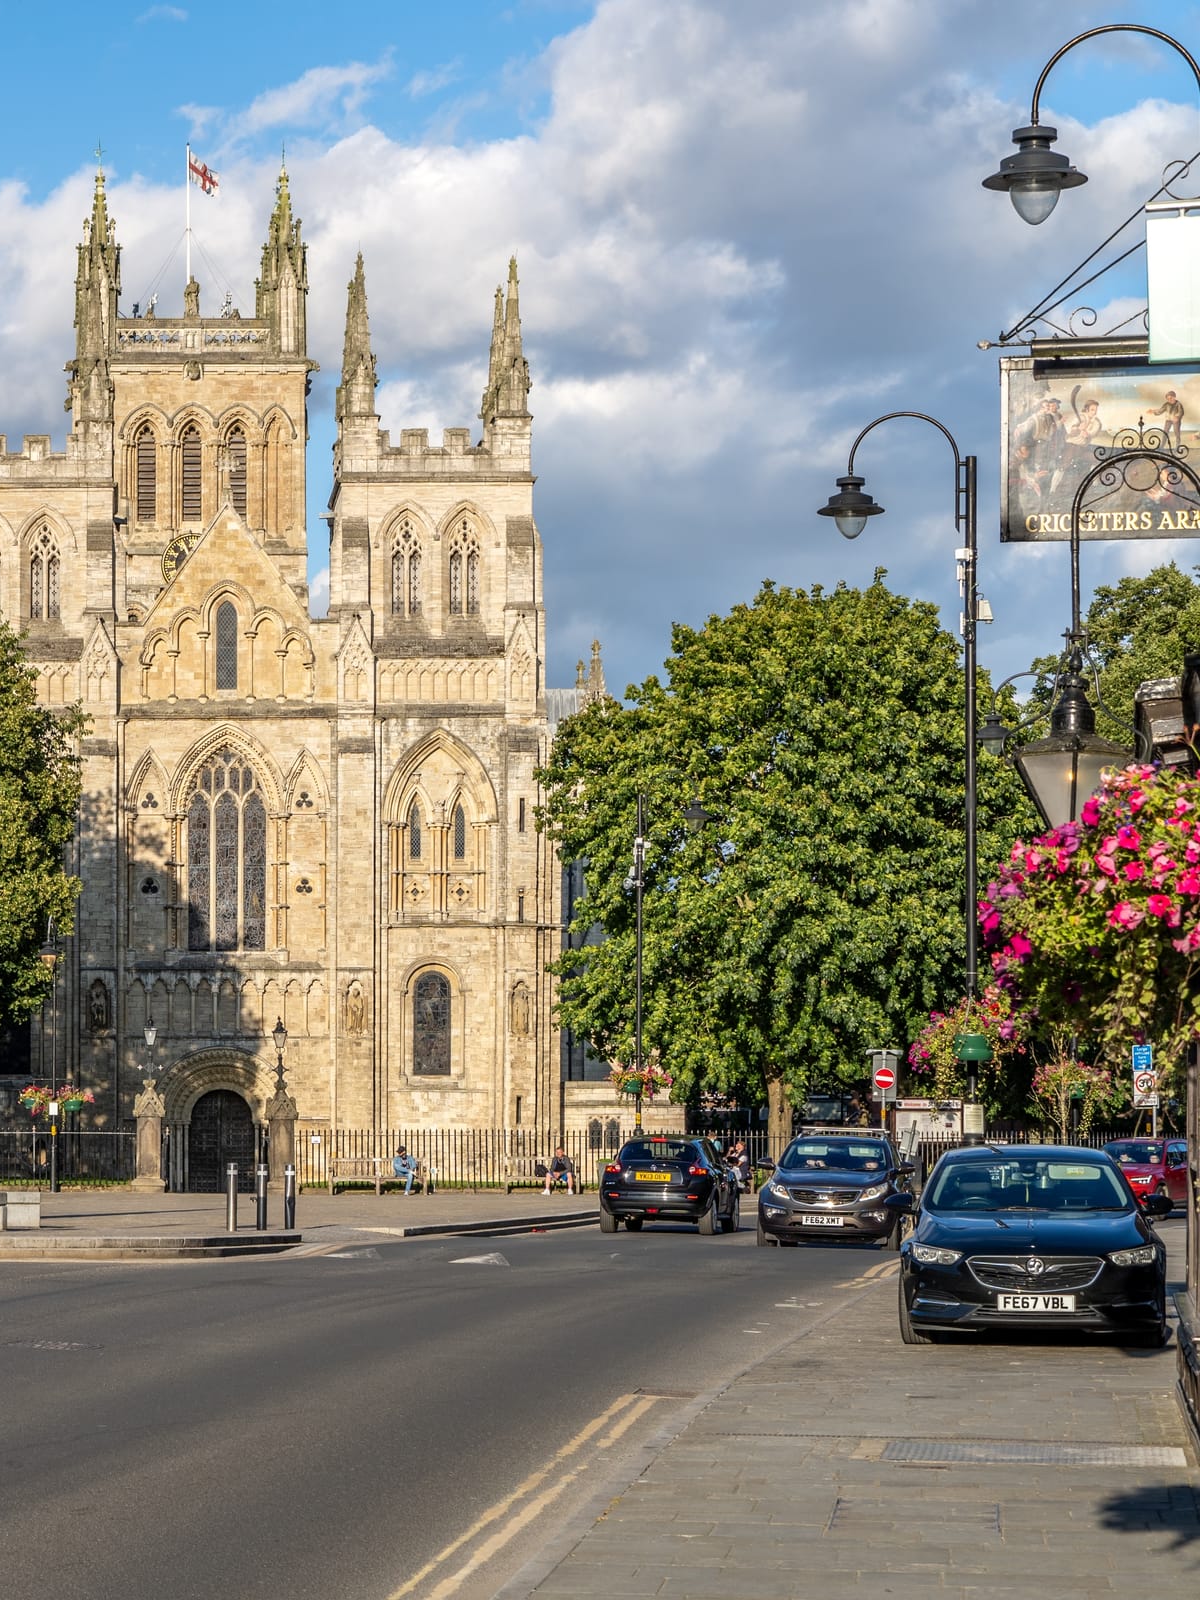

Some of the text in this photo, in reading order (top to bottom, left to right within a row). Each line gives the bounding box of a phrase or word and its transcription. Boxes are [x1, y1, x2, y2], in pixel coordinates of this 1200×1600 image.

[1025, 512, 1152, 533] CRICKETERS
[826, 1217, 841, 1225] XMT
[1003, 1296, 1069, 1310] FE67 VBL
